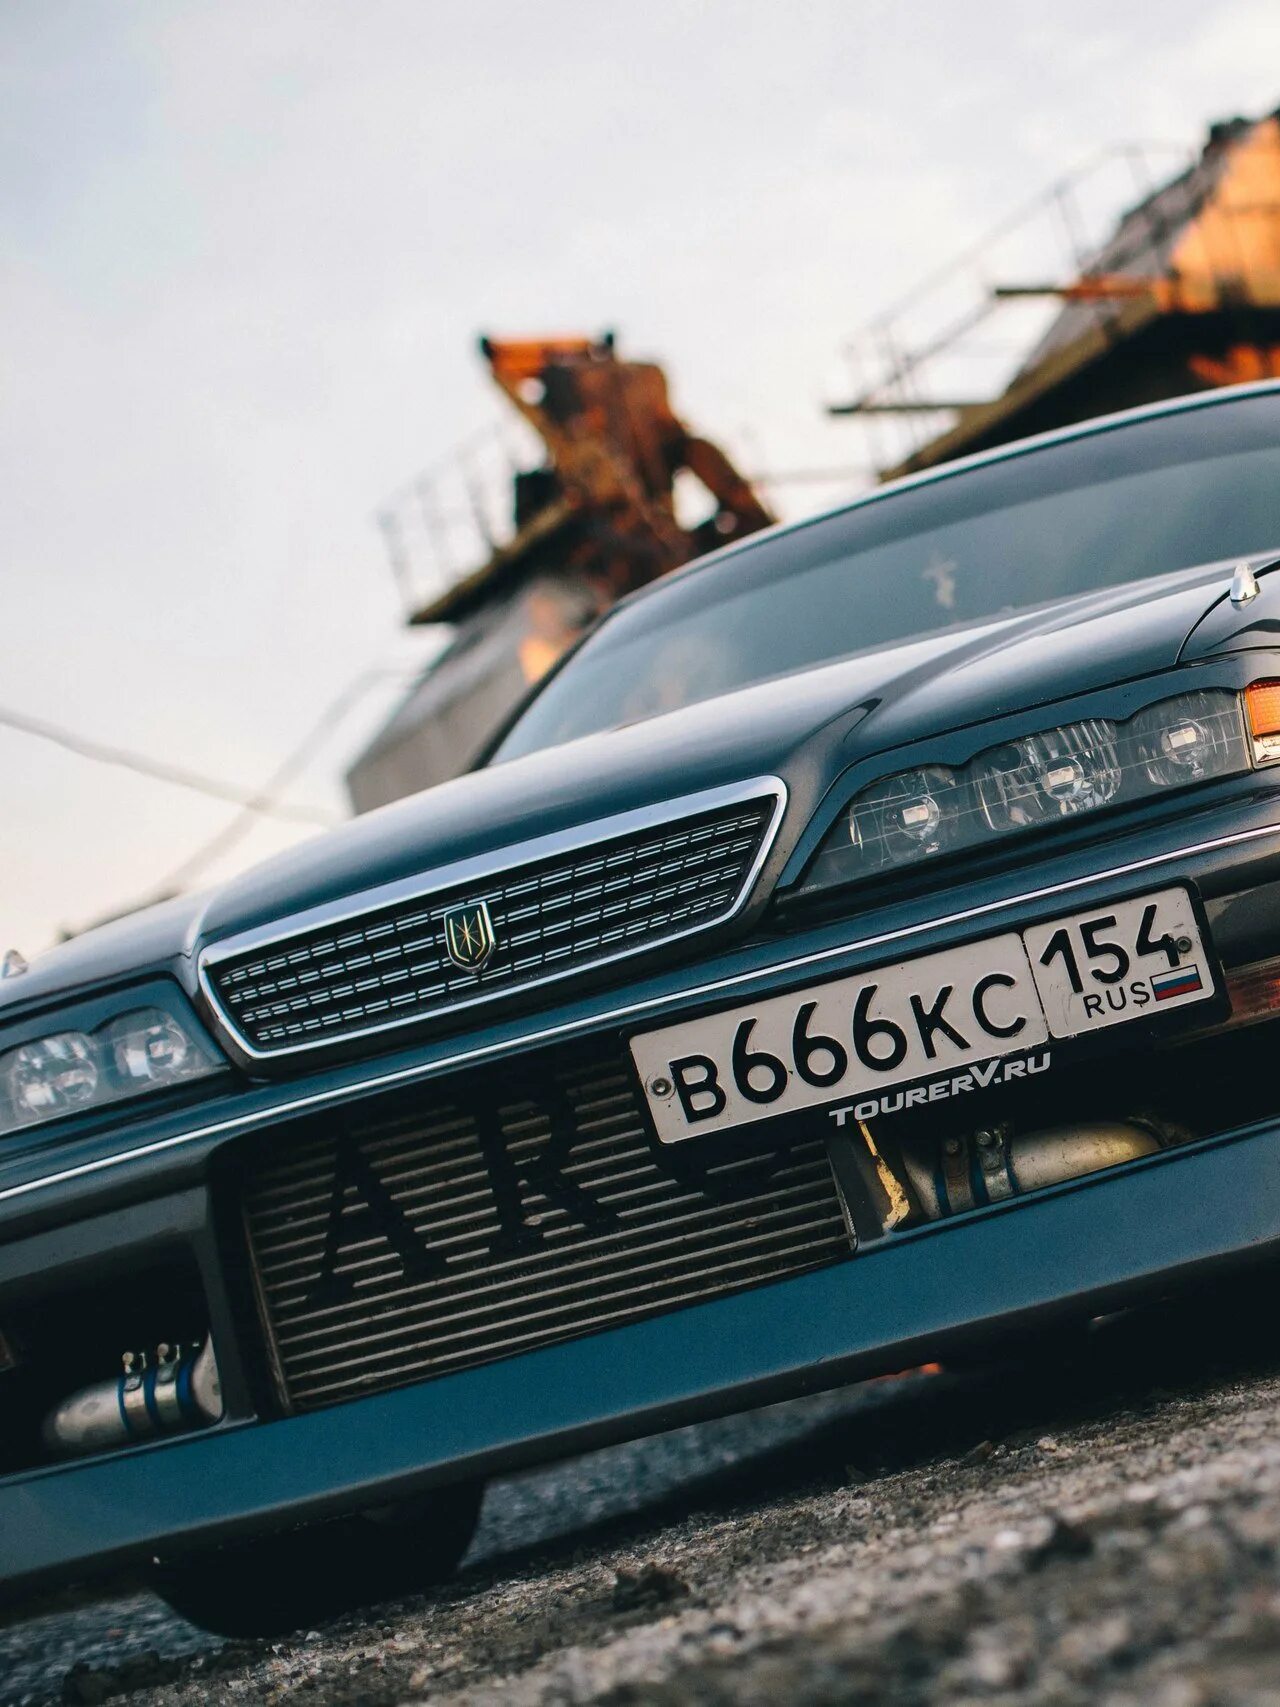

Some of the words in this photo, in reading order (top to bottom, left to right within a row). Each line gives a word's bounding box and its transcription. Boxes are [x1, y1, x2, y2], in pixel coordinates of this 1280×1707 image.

[1039, 904, 1180, 993] 154
[1083, 982, 1150, 1018] RUS
[829, 1053, 1051, 1127] TOURERV.RU
